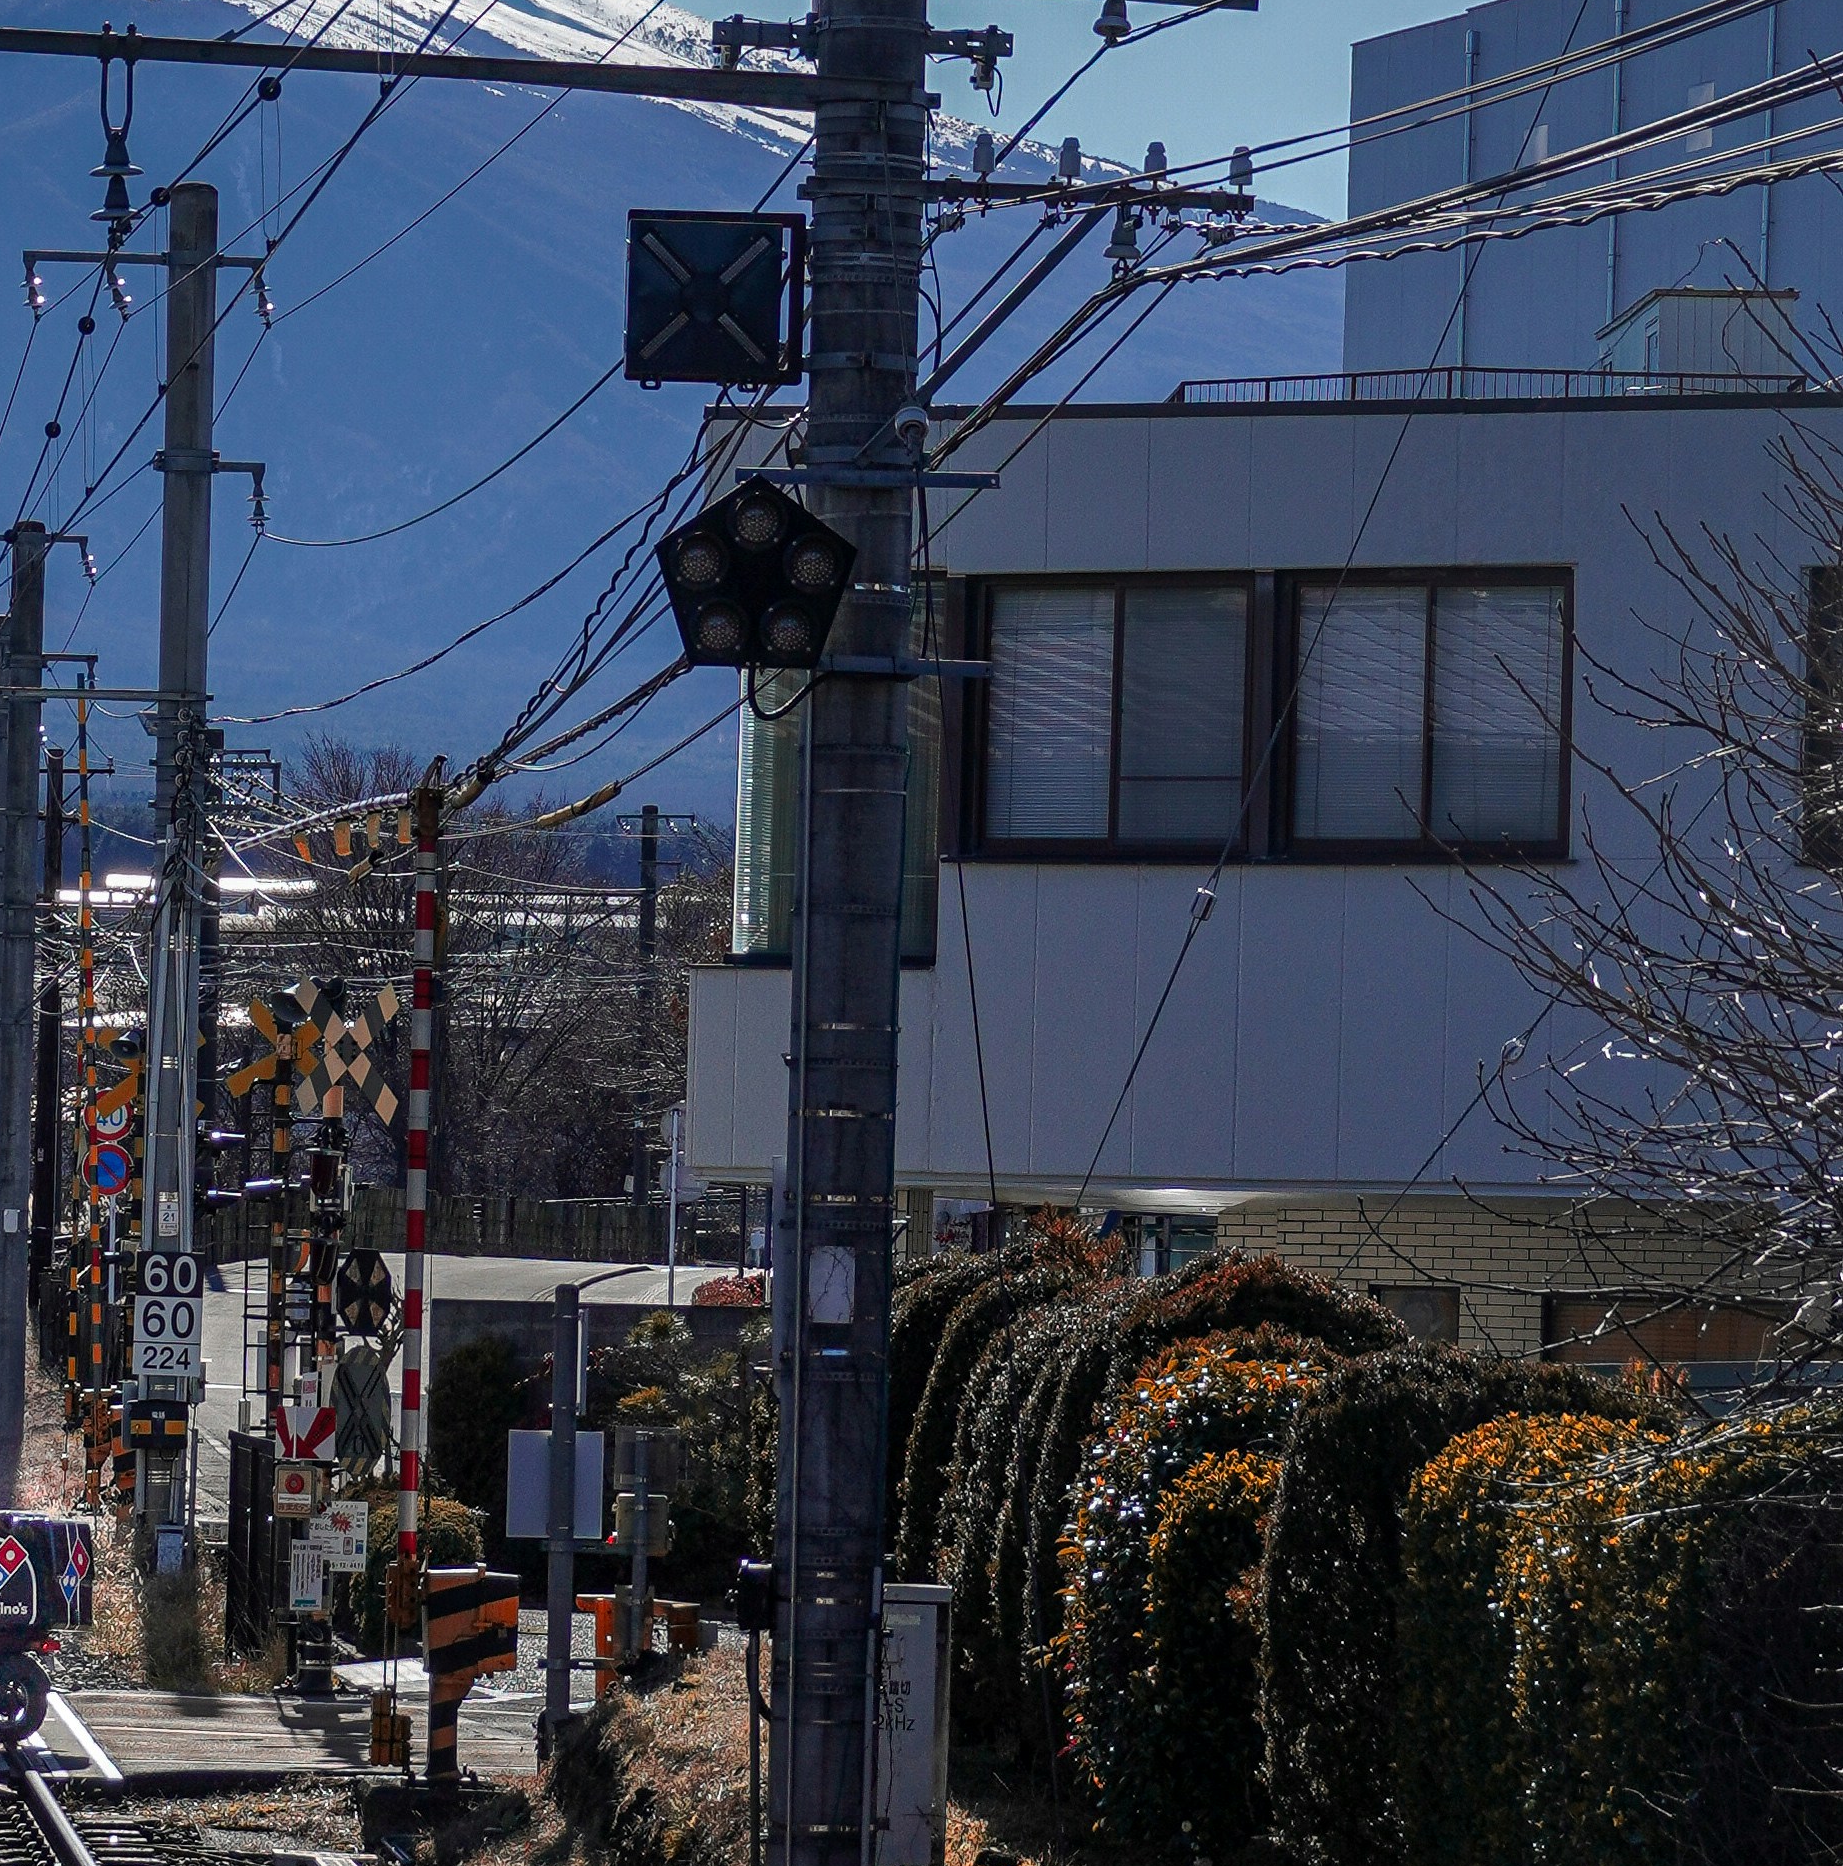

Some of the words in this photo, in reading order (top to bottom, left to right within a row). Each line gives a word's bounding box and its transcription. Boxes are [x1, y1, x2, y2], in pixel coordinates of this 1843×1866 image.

[162, 1212, 175, 1222] 21
[144, 1254, 198, 1294] 60
[142, 1300, 195, 1339] 60
[142, 1345, 191, 1370] 224
